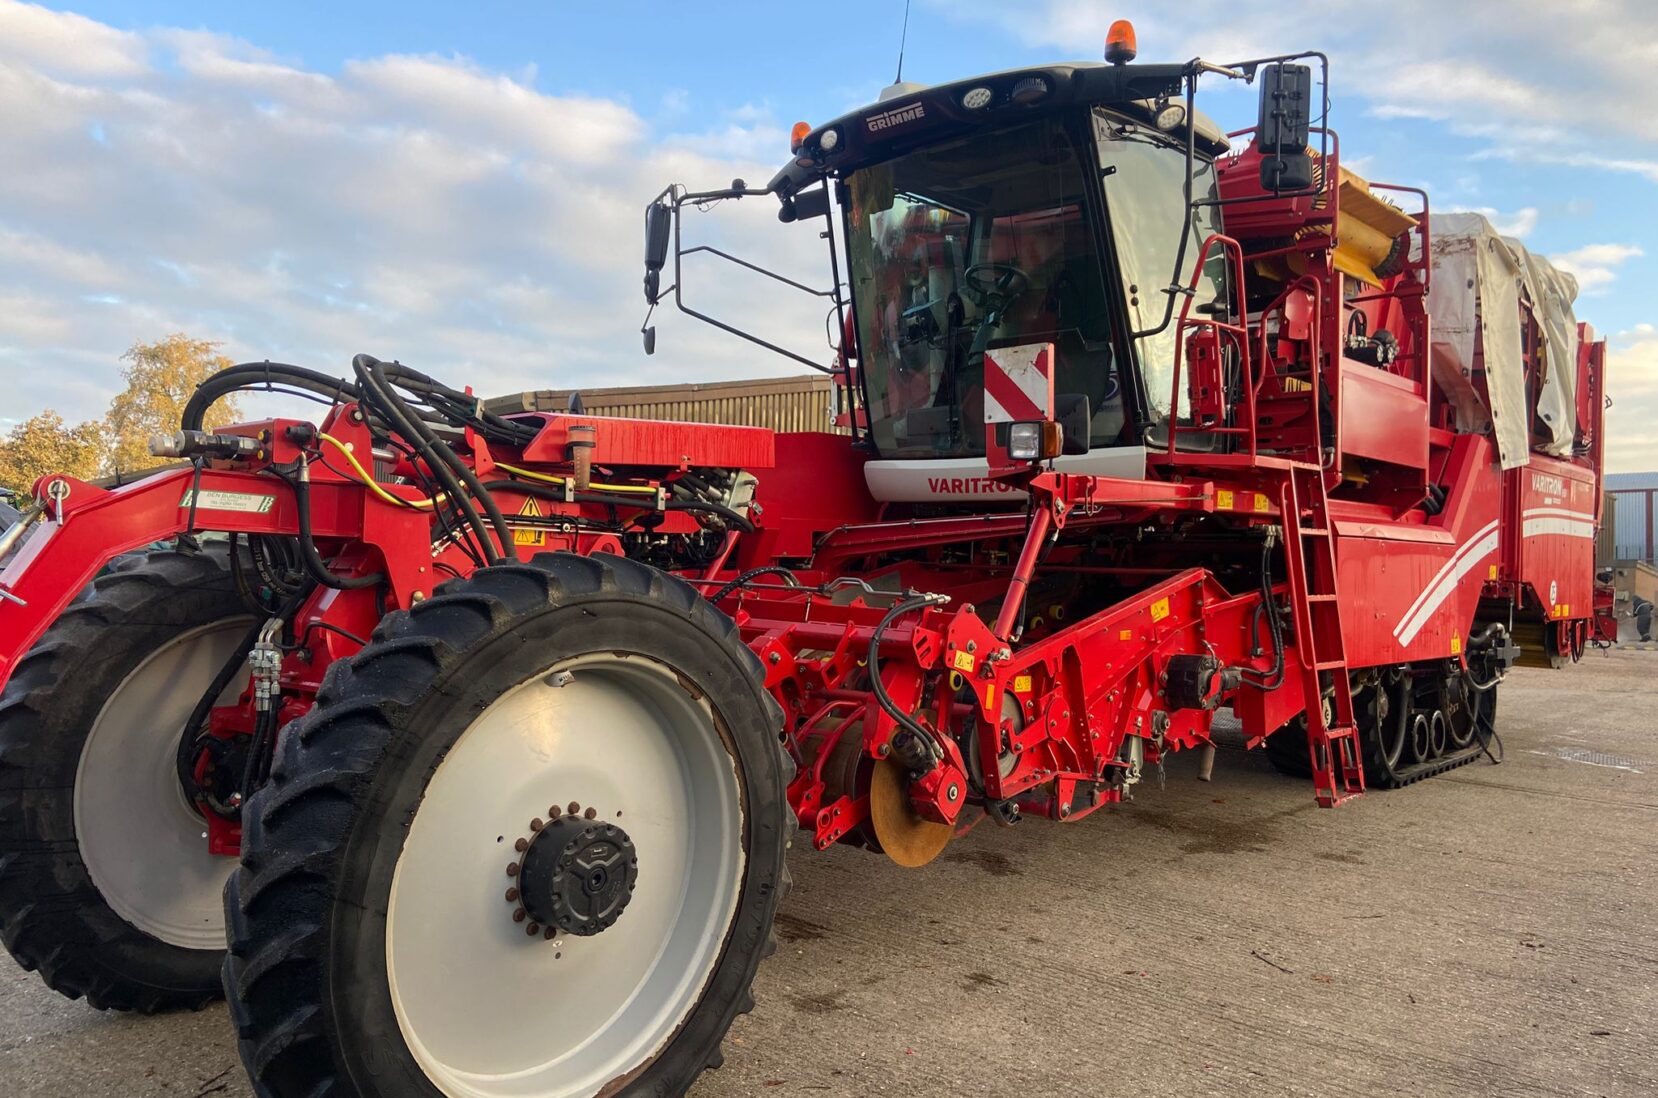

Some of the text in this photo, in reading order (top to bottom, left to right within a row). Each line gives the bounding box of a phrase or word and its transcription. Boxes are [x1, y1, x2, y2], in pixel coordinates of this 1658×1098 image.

[867, 106, 925, 132] GRIMME
[928, 478, 1017, 494] VARITRO
[1532, 473, 1562, 496] VARITRON
